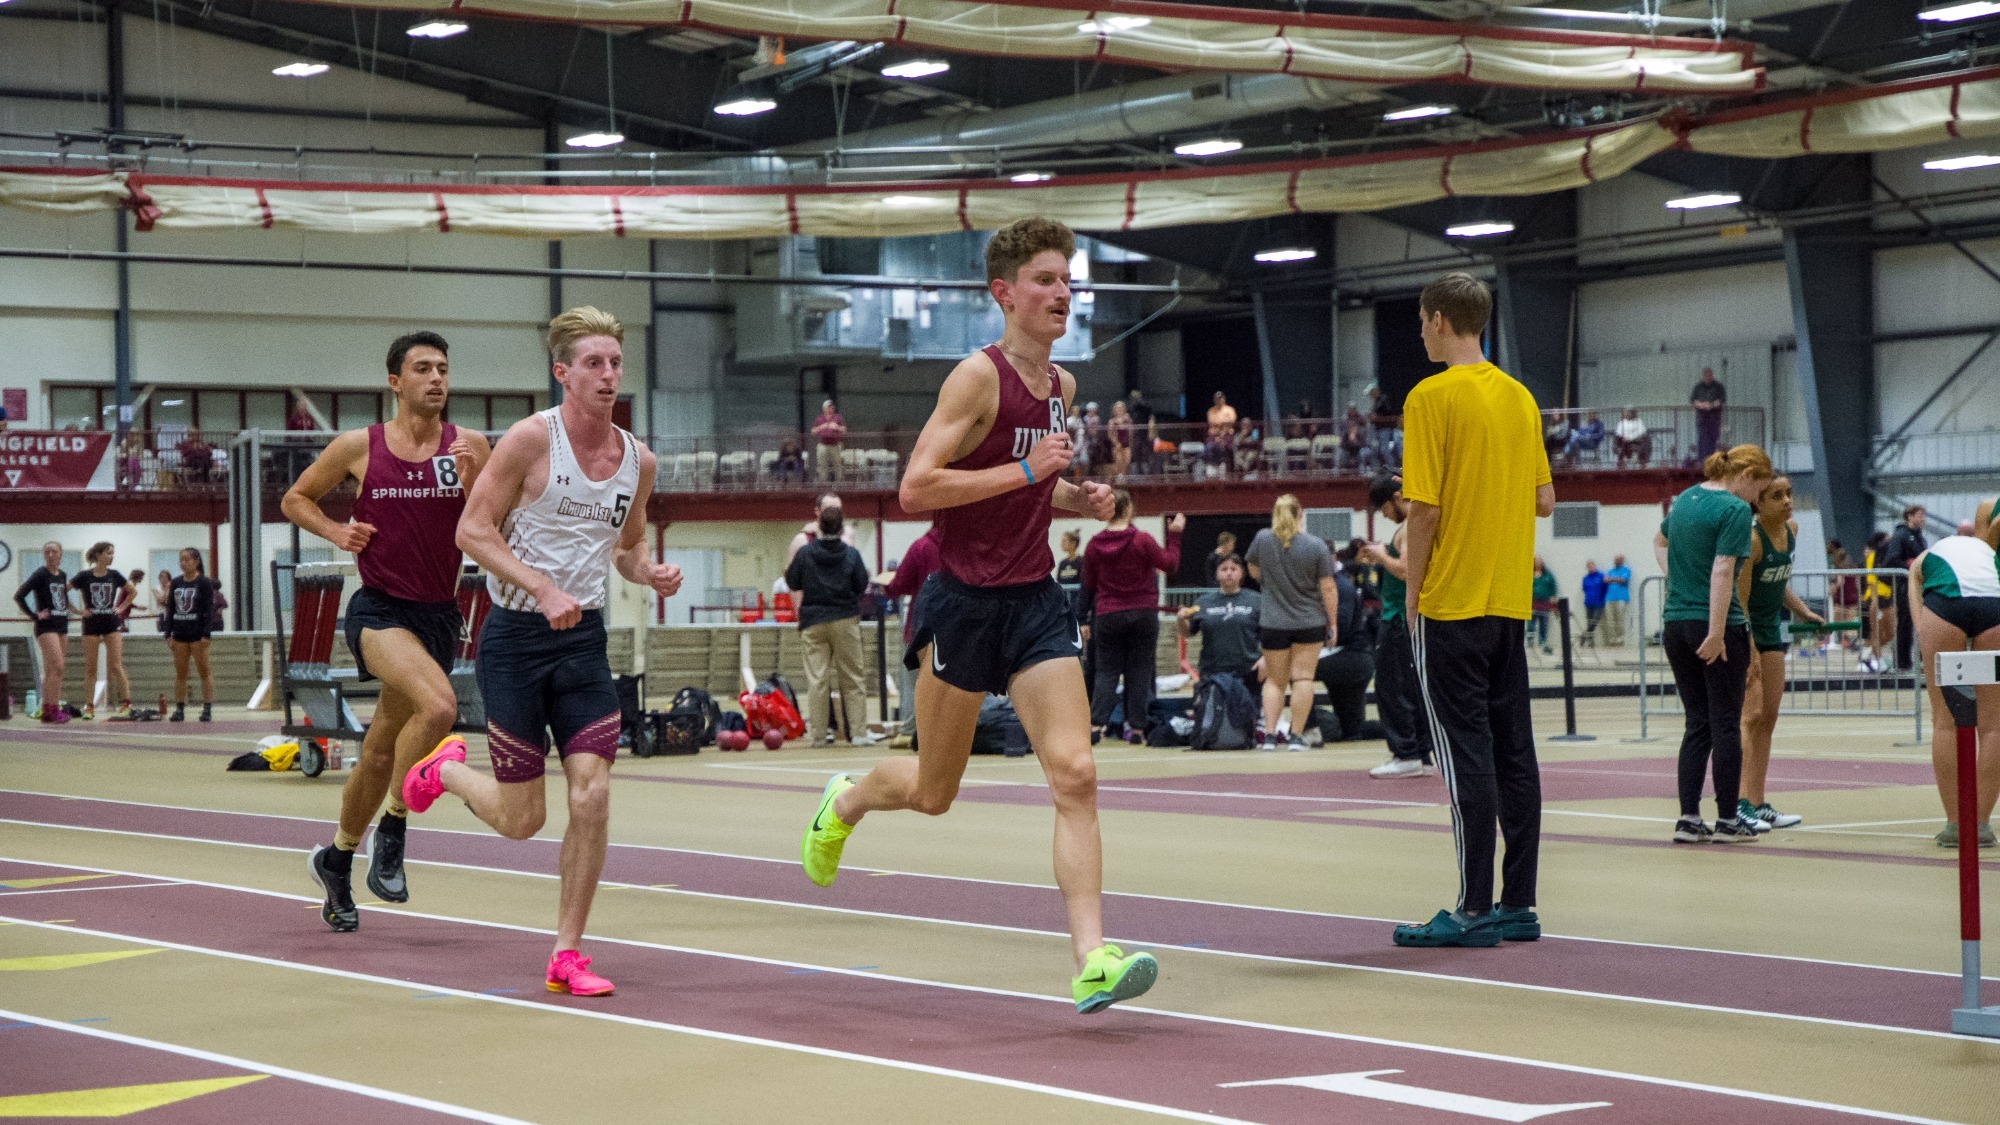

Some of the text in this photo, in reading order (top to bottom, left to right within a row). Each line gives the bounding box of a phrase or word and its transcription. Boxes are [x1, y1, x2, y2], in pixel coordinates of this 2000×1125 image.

[1051, 400, 1064, 433] 3
[437, 458, 459, 487] 8
[371, 487, 460, 499] SPRINGFIELD
[611, 493, 631, 528] 5
